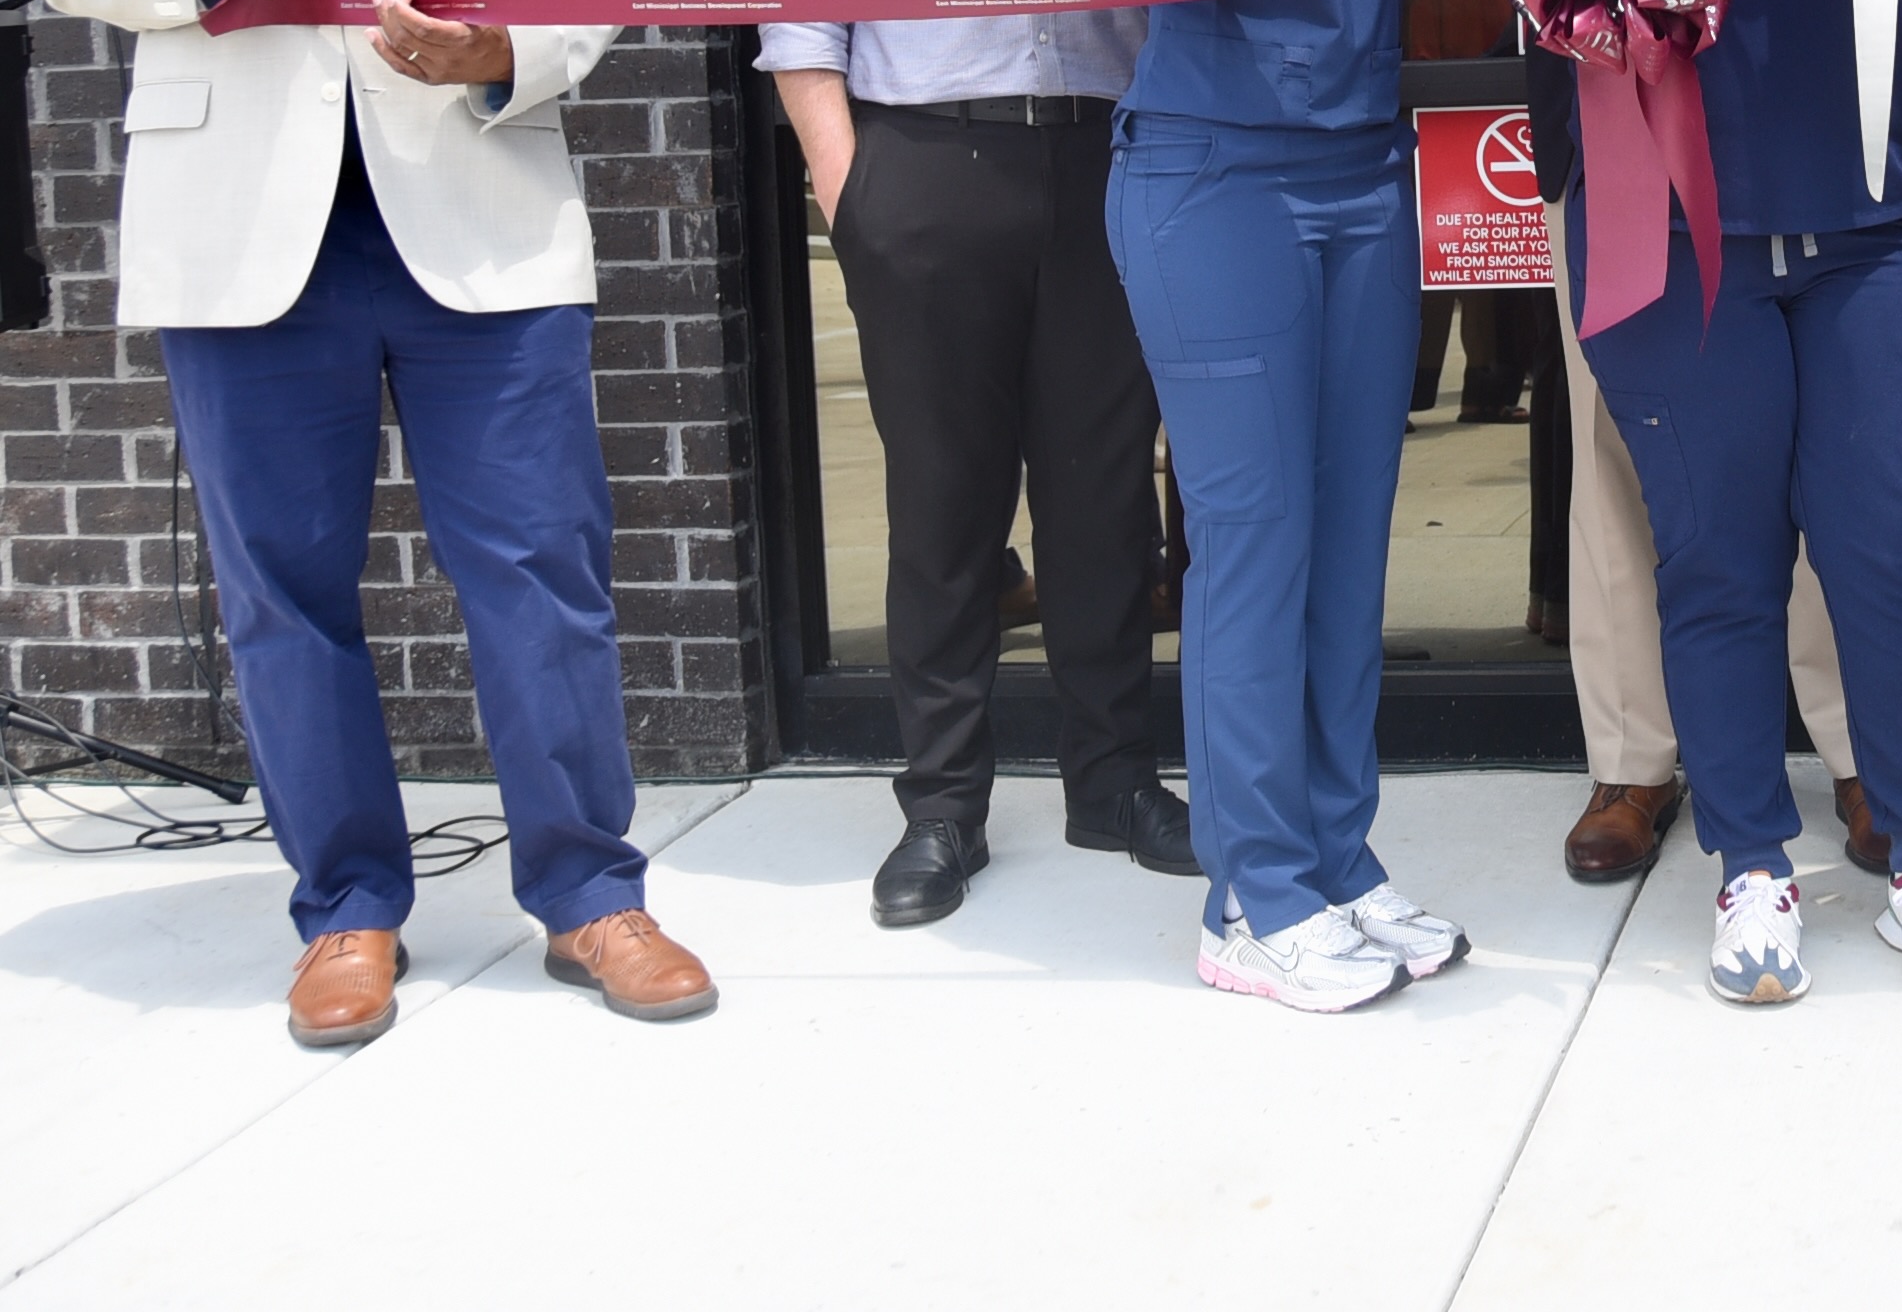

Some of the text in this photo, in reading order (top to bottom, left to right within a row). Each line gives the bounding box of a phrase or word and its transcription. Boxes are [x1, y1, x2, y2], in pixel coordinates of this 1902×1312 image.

[1436, 214, 1461, 226] DUE
[1464, 213, 1483, 225] TO
[1486, 212, 1537, 225] HEALTH
[1463, 226, 1548, 239] FOR OUR PAT
[1438, 242, 1459, 254] WE
[1462, 242, 1489, 254] ASK
[1491, 240, 1526, 253] THAT
[1447, 254, 1551, 268] FROM SMOKING
[1429, 270, 1471, 282] WHILE
[1473, 269, 1529, 281] VISITING
